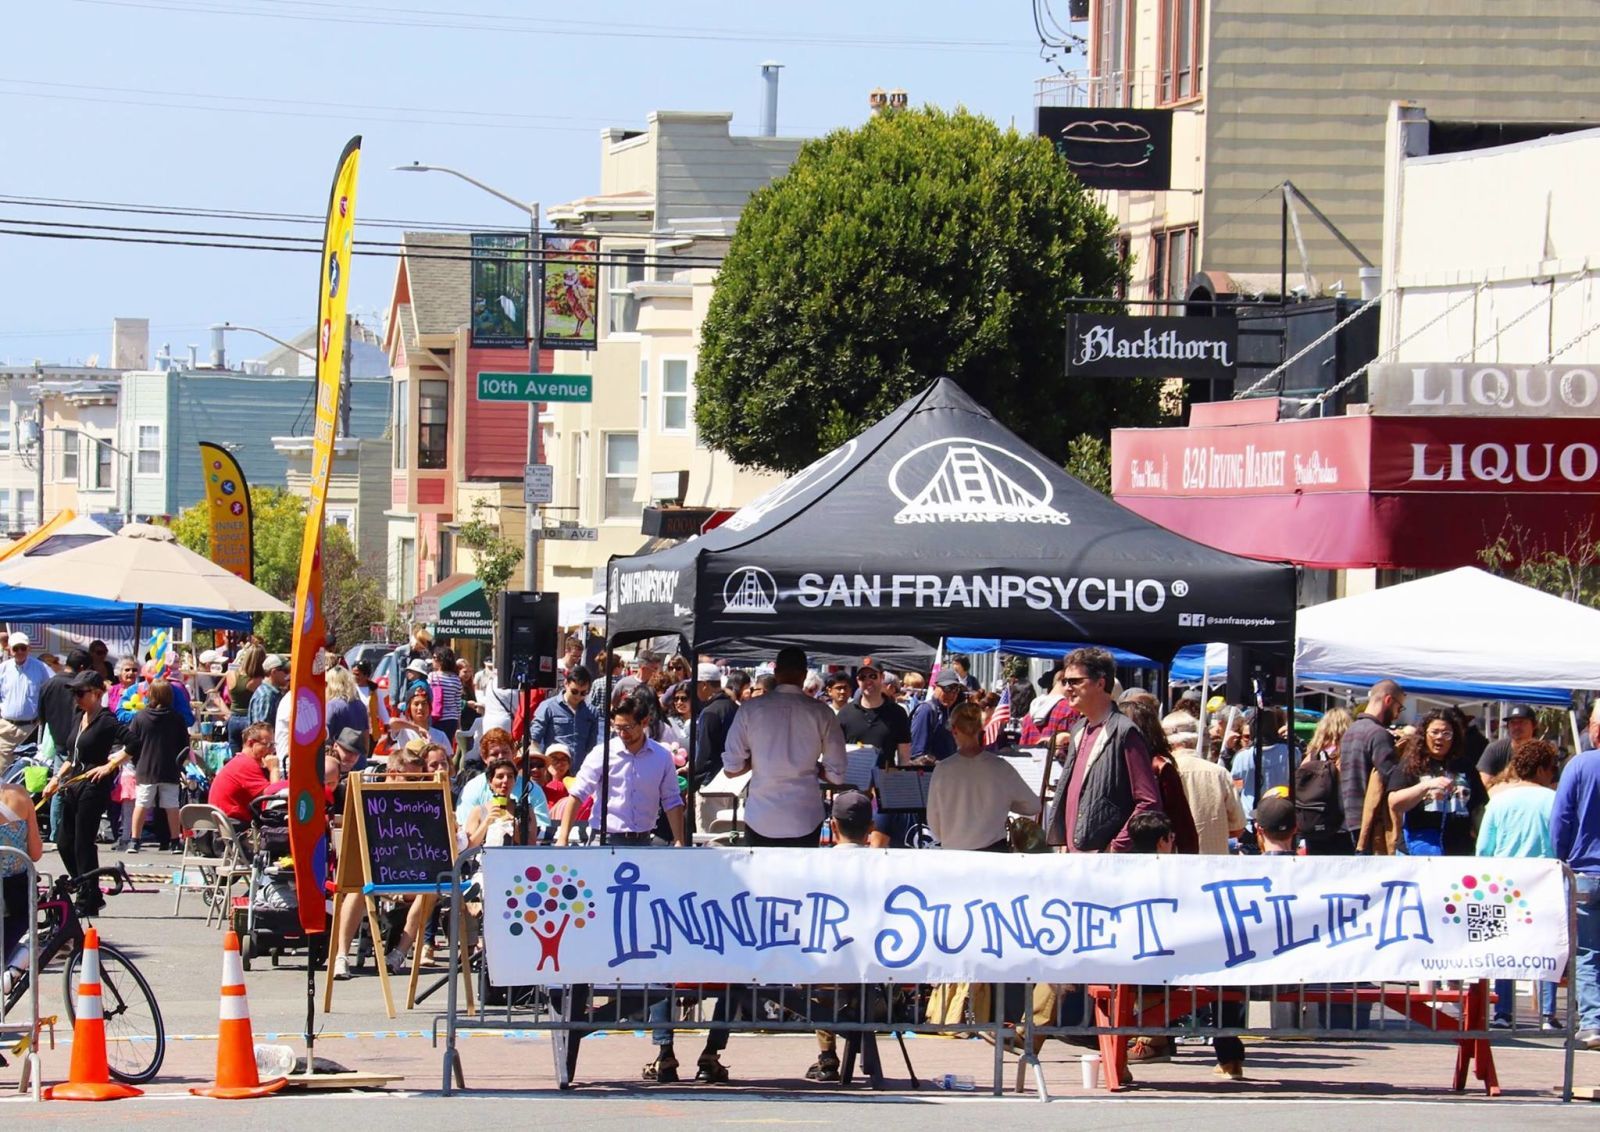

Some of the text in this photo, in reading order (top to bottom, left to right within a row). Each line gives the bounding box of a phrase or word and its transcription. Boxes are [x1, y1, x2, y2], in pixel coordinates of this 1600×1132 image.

[1072, 325, 1234, 367] Blackthorn
[482, 379, 588, 396] 10th Avenue
[1182, 447, 1207, 489] 828
[1408, 442, 1599, 484] LIQUO
[893, 512, 1071, 526] SAN FRANPSYCHO
[570, 530, 594, 538] AVE
[798, 573, 881, 608] SAN
[450, 610, 481, 618] WAXING
[1206, 616, 1276, 627] @sanfranpsycho
[367, 797, 441, 820] NO Smoking
[377, 816, 425, 839] Walk
[372, 841, 449, 863] your bikes
[379, 865, 428, 882] Please
[606, 861, 1435, 968] INNER SUNSET FLEA
[1421, 952, 1557, 971] www.isflea.com
